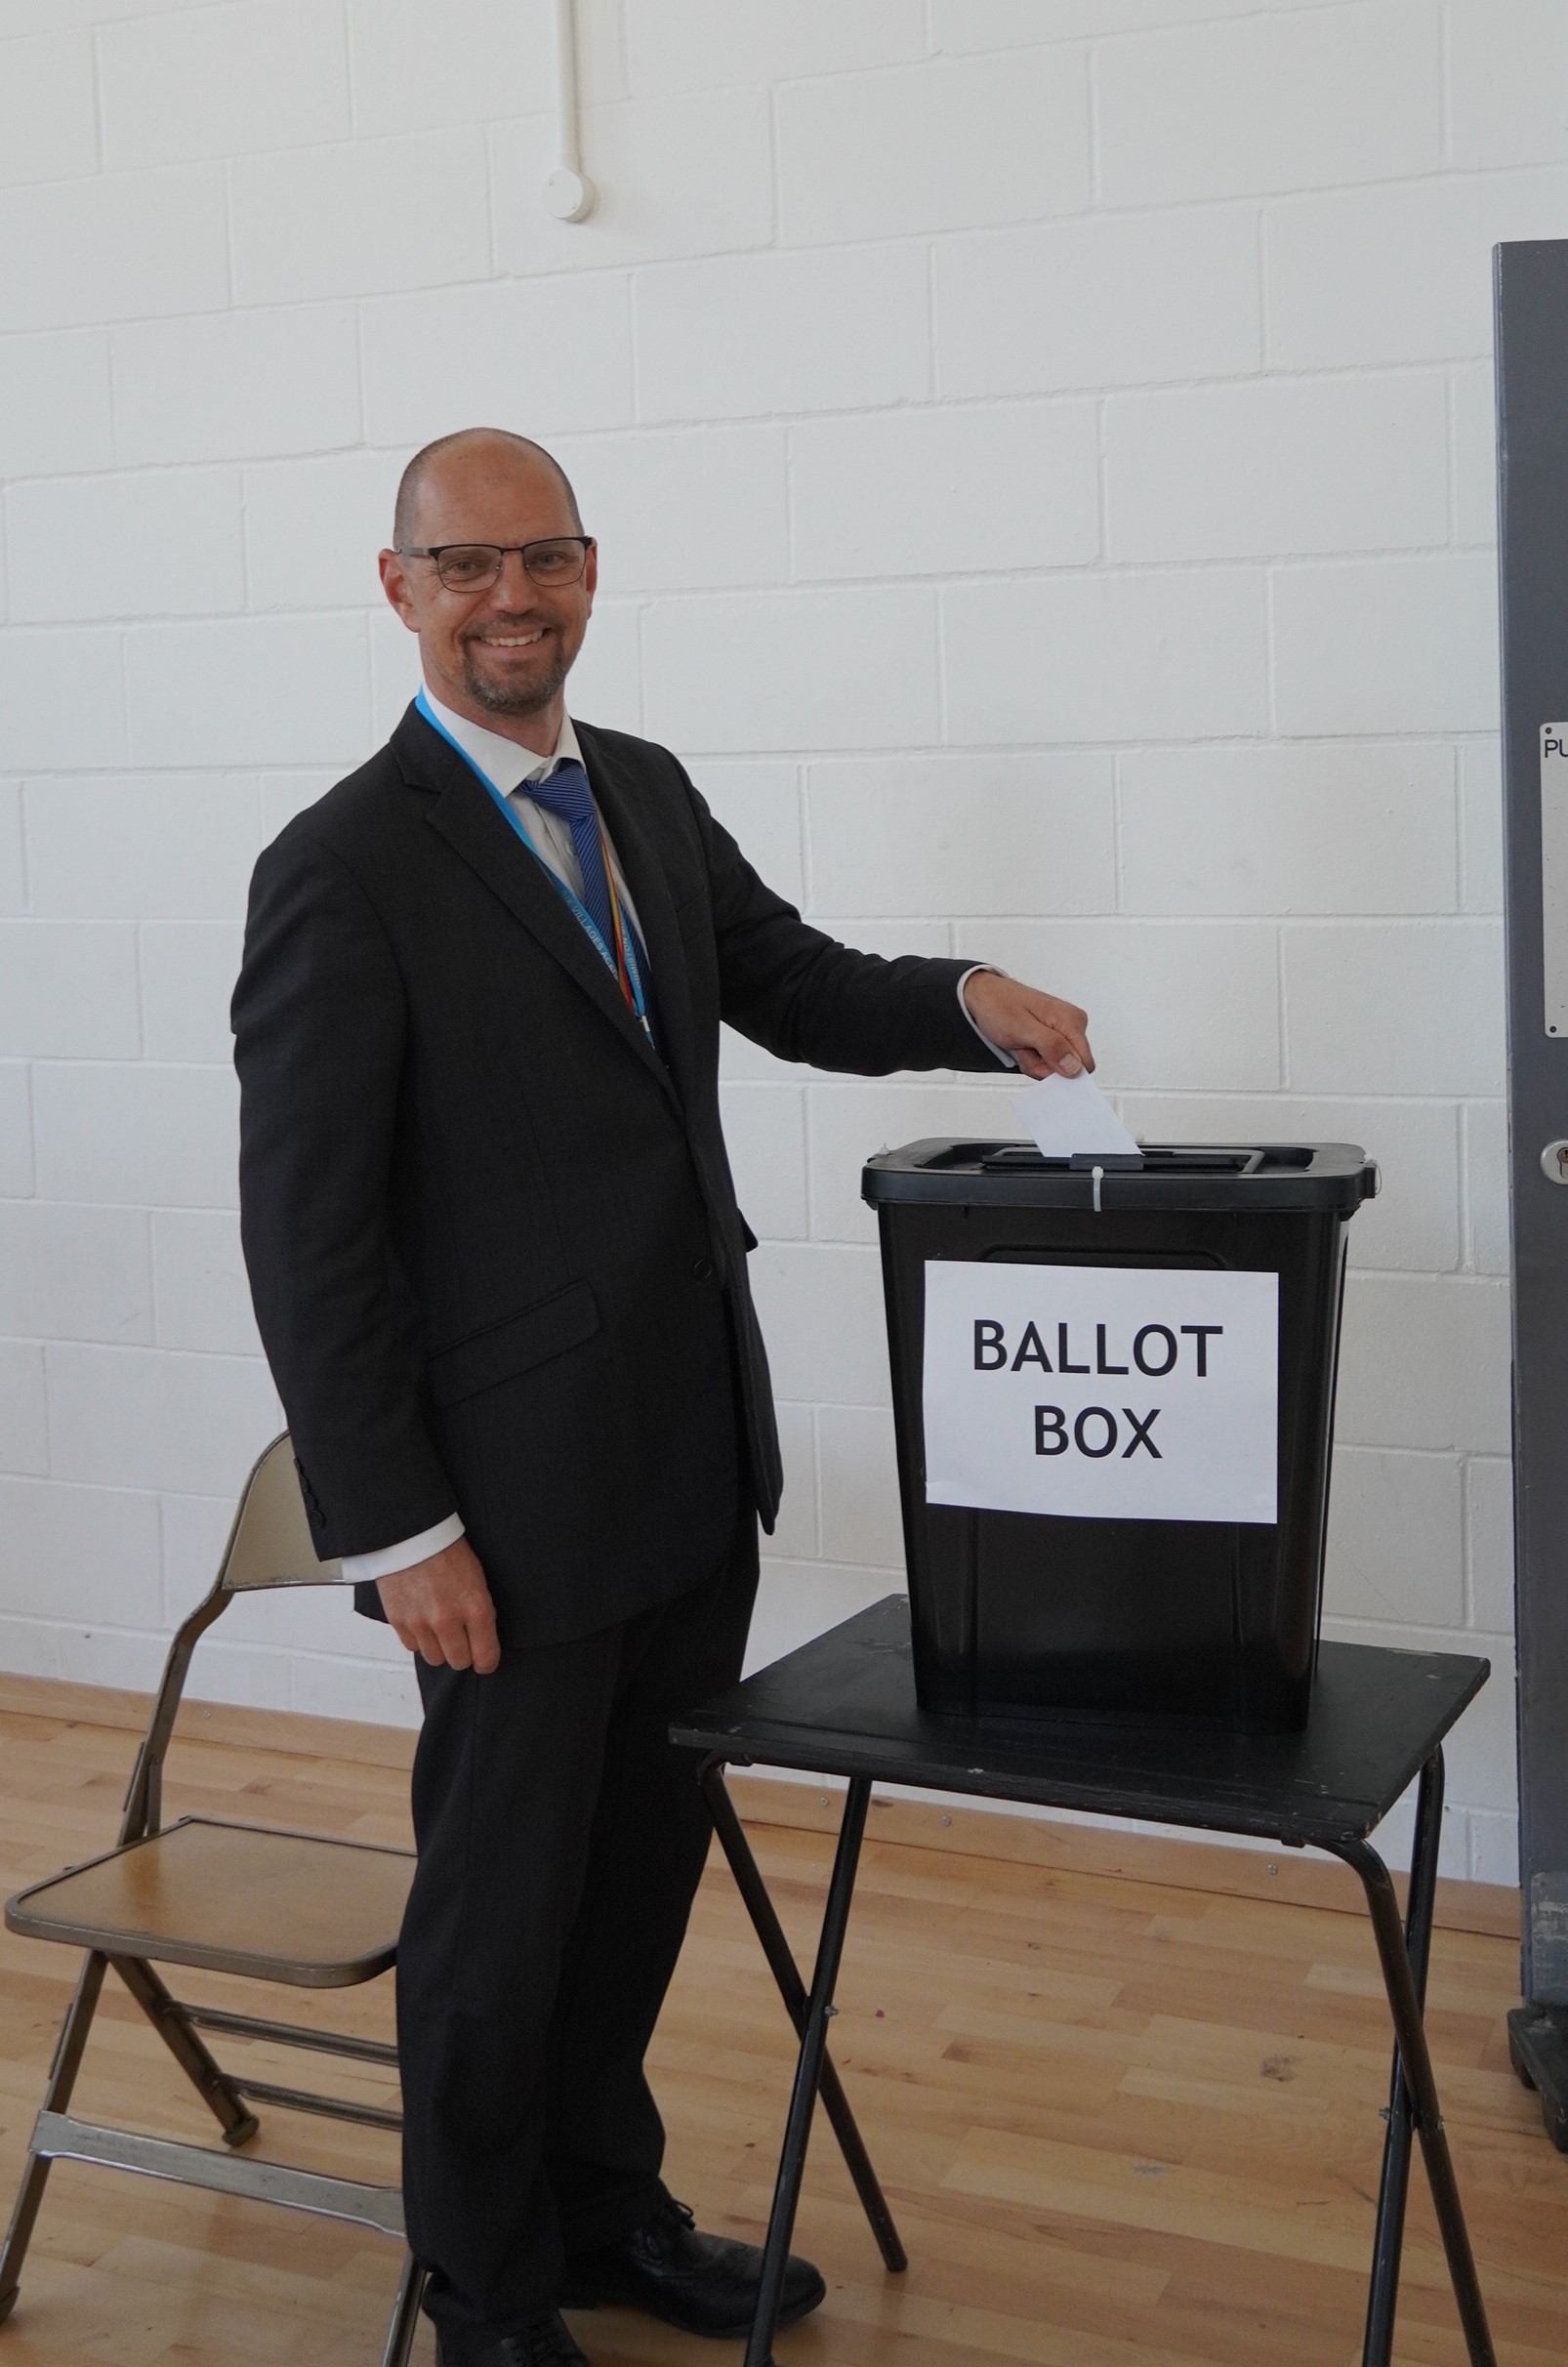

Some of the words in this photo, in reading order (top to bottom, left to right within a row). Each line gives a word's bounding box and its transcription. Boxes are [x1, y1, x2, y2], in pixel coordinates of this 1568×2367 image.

[572, 907, 603, 951] VILLAGES
[974, 1320, 1222, 1377] BALLOT
[1035, 1405, 1163, 1458] BOX
